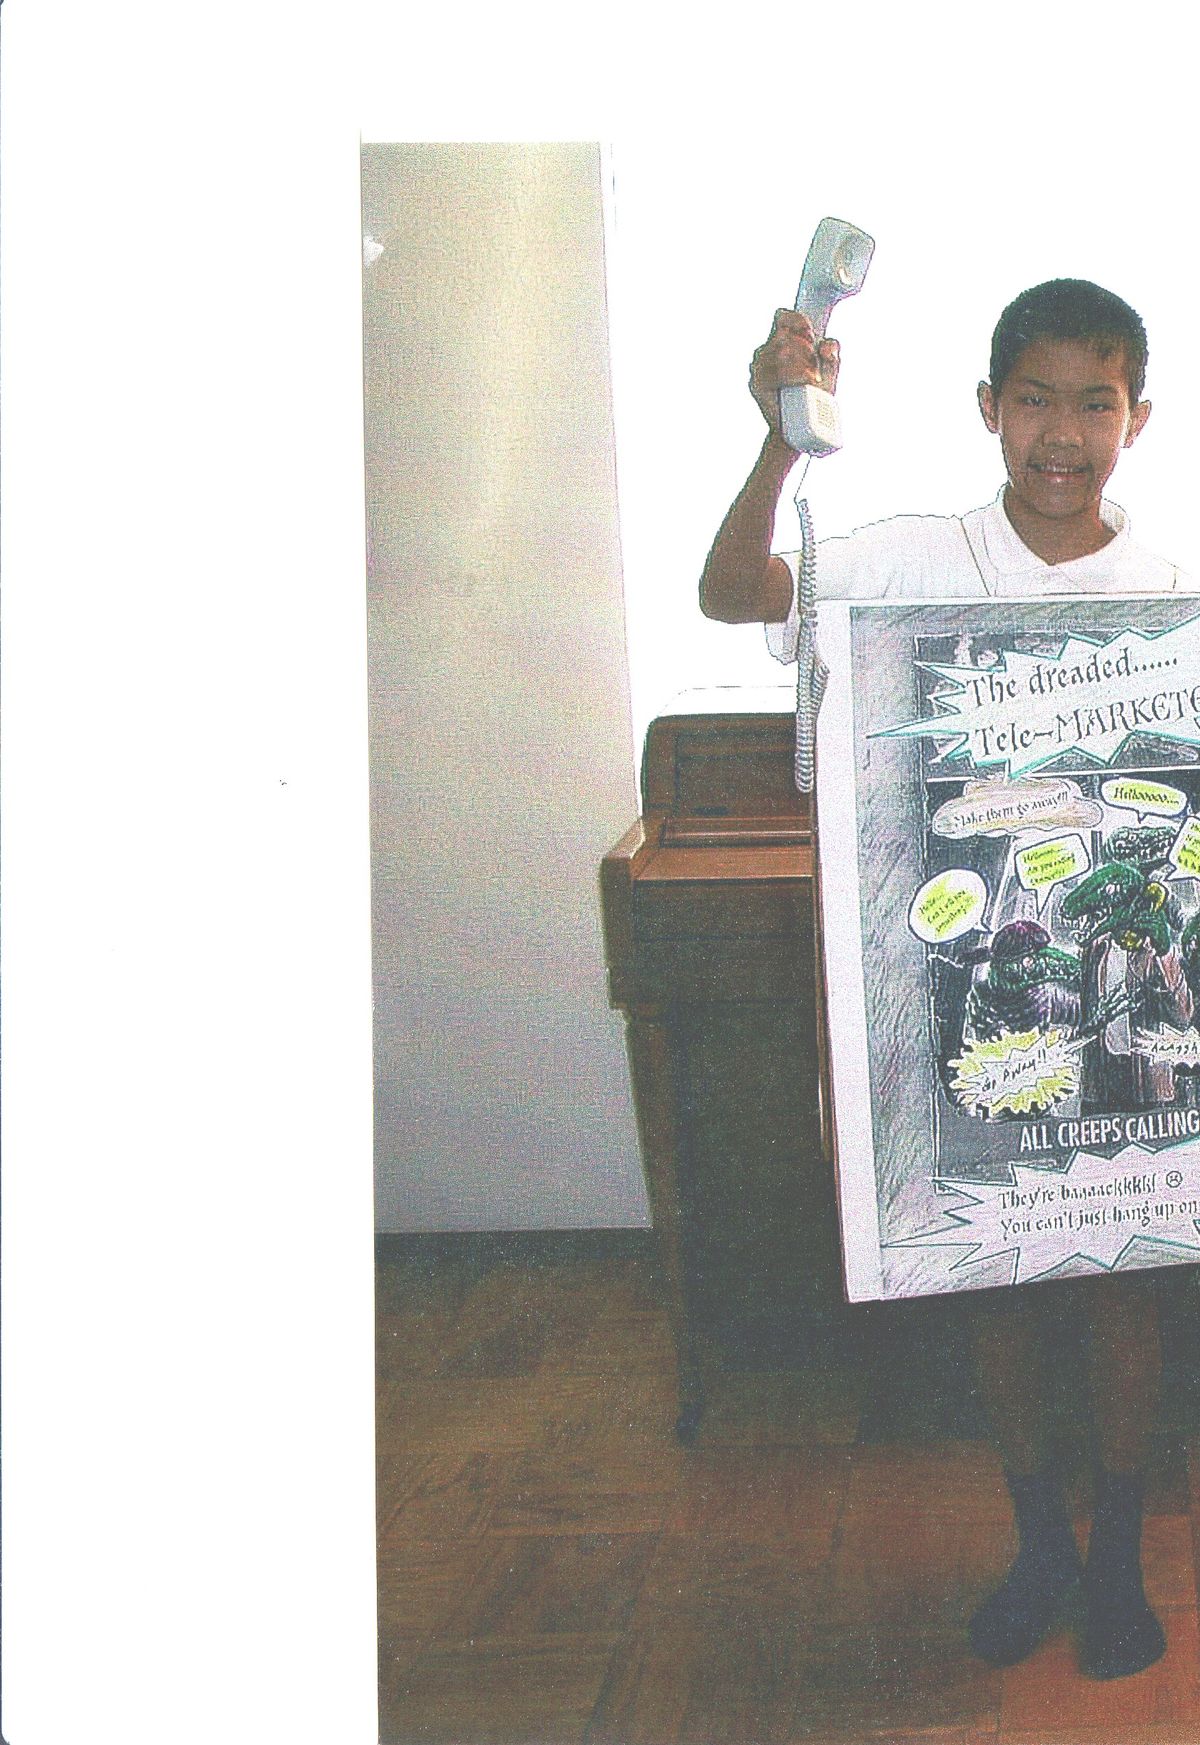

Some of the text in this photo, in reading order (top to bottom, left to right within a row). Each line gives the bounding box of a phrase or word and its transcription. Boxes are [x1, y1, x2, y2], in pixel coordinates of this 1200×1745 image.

[966, 676, 1018, 709] The
[986, 807, 1013, 822] them
[1016, 803, 1029, 819] go
[1020, 1125, 1052, 1152] ALL
[1057, 1117, 1121, 1148] CREEPS
[998, 1186, 1055, 1210] They're
[1000, 1218, 1031, 1242] You
[1036, 1211, 1073, 1231] can't
[1076, 1207, 1106, 1231] just
[1113, 1200, 1151, 1230] hang
[1154, 1203, 1174, 1221] up
[1179, 1200, 1197, 1214] on
